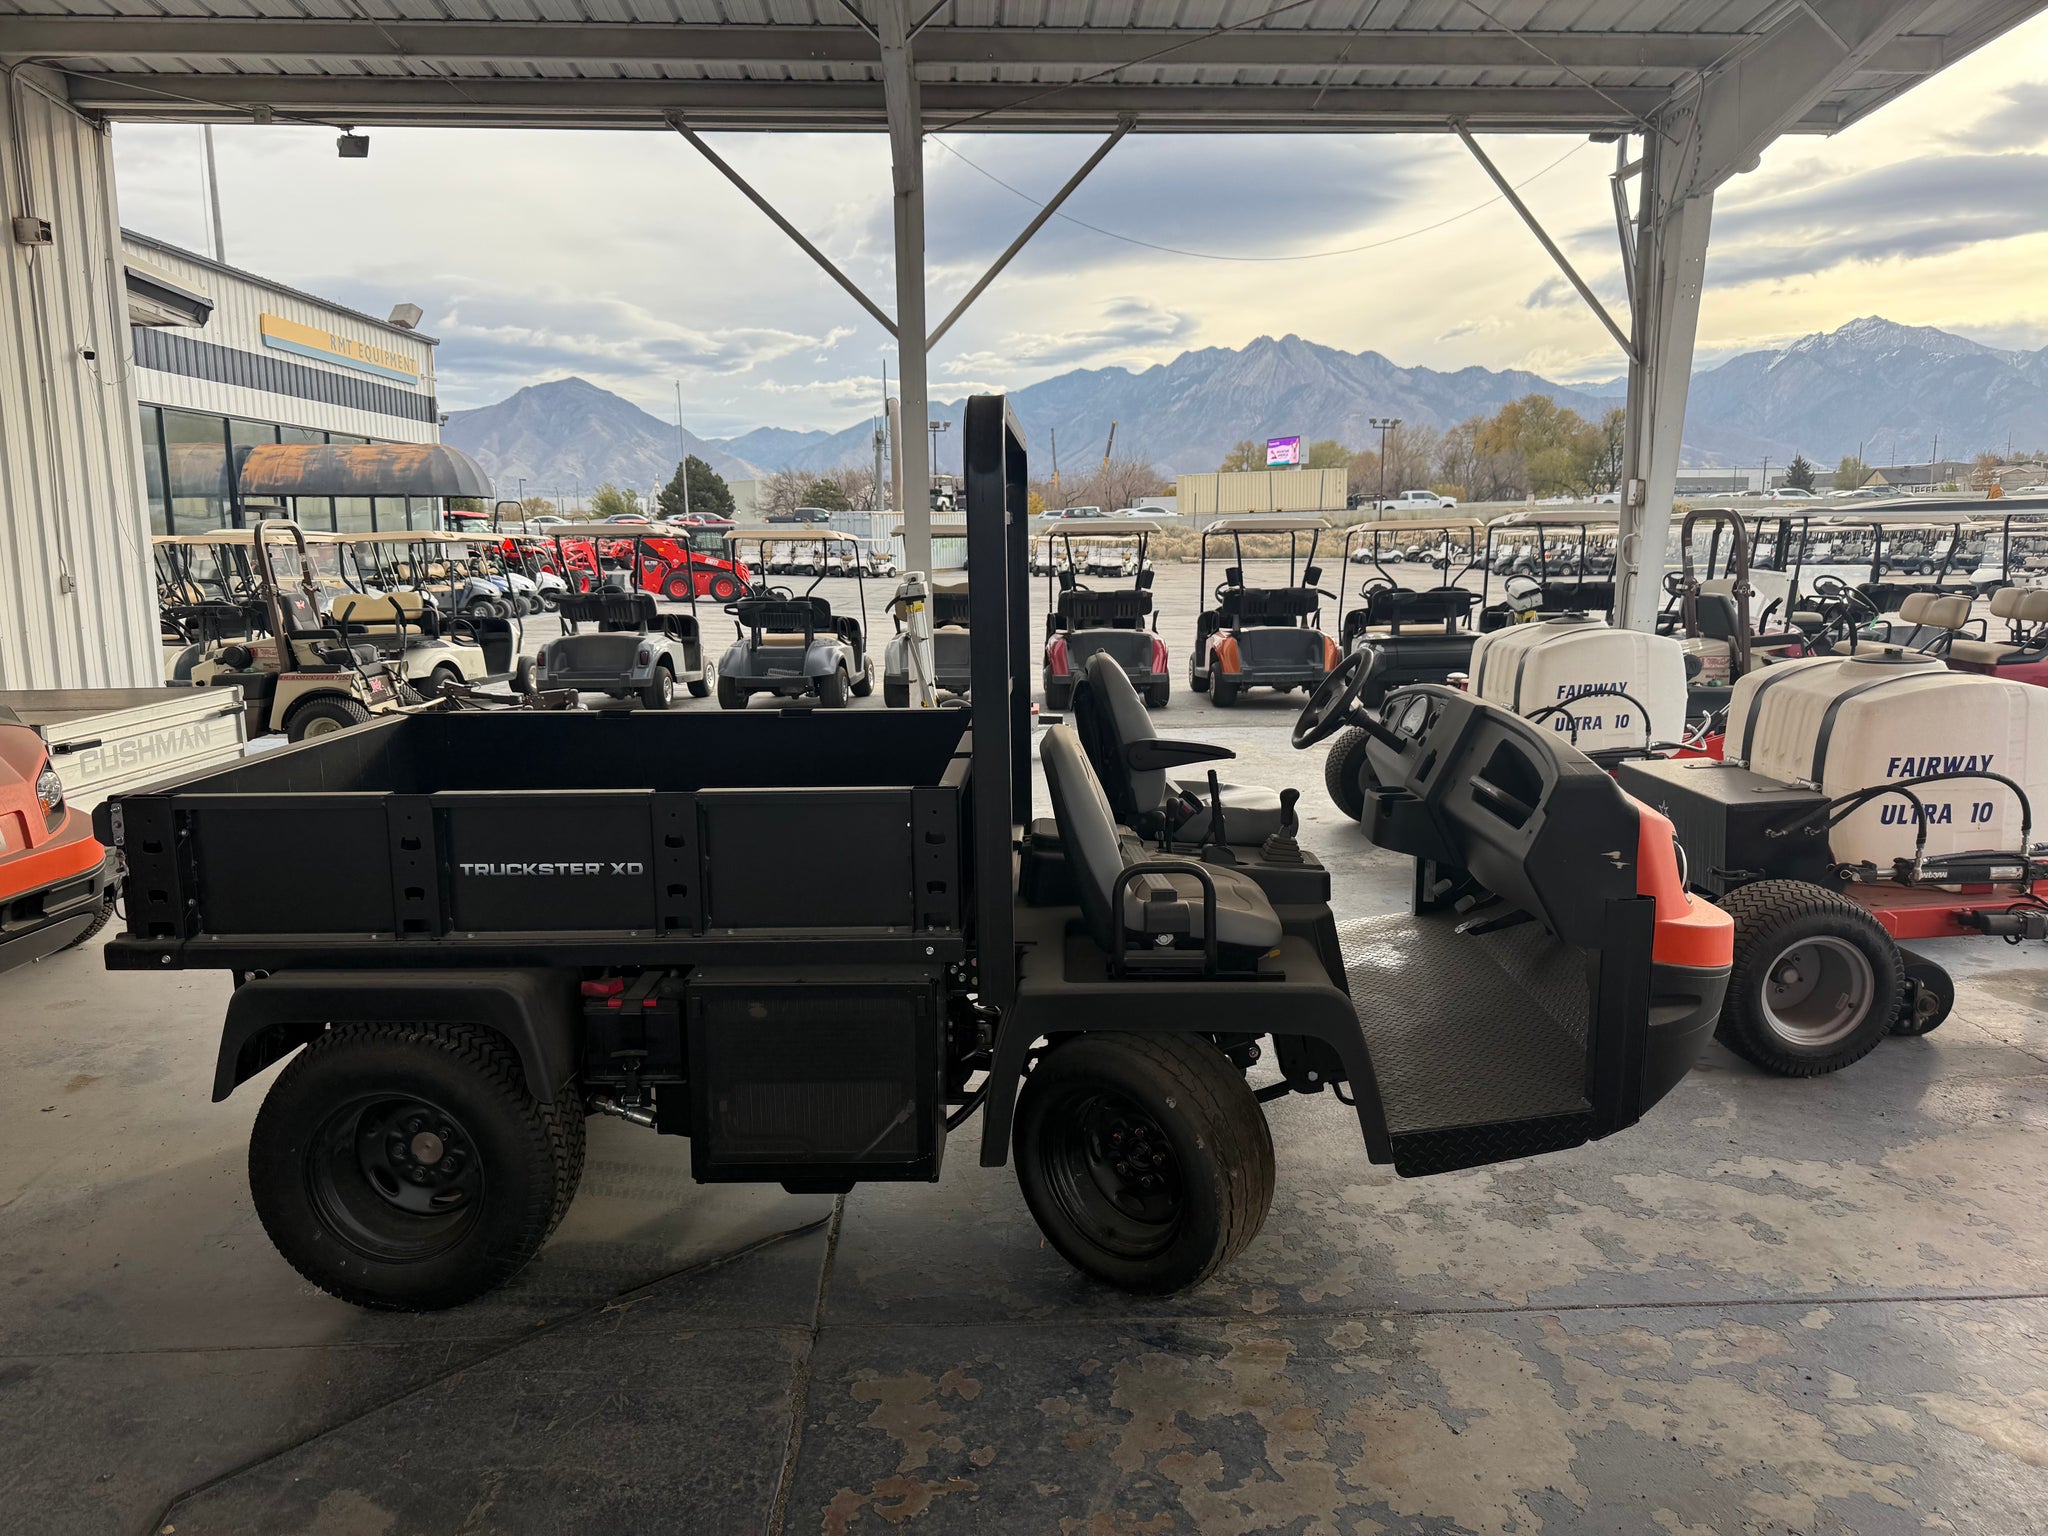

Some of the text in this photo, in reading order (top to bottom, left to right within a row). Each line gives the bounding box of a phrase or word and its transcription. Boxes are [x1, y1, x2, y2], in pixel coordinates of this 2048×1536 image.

[330, 334, 415, 373] RMT EQUIPMENT
[1556, 682, 1628, 699] FAIRWAY
[1554, 713, 1630, 732] ULTRA 10
[80, 723, 211, 779] CUSHMAN
[1886, 754, 1994, 778] FAIRWAY
[1880, 801, 1994, 825] ULTRA 10
[610, 861, 644, 876] XD
